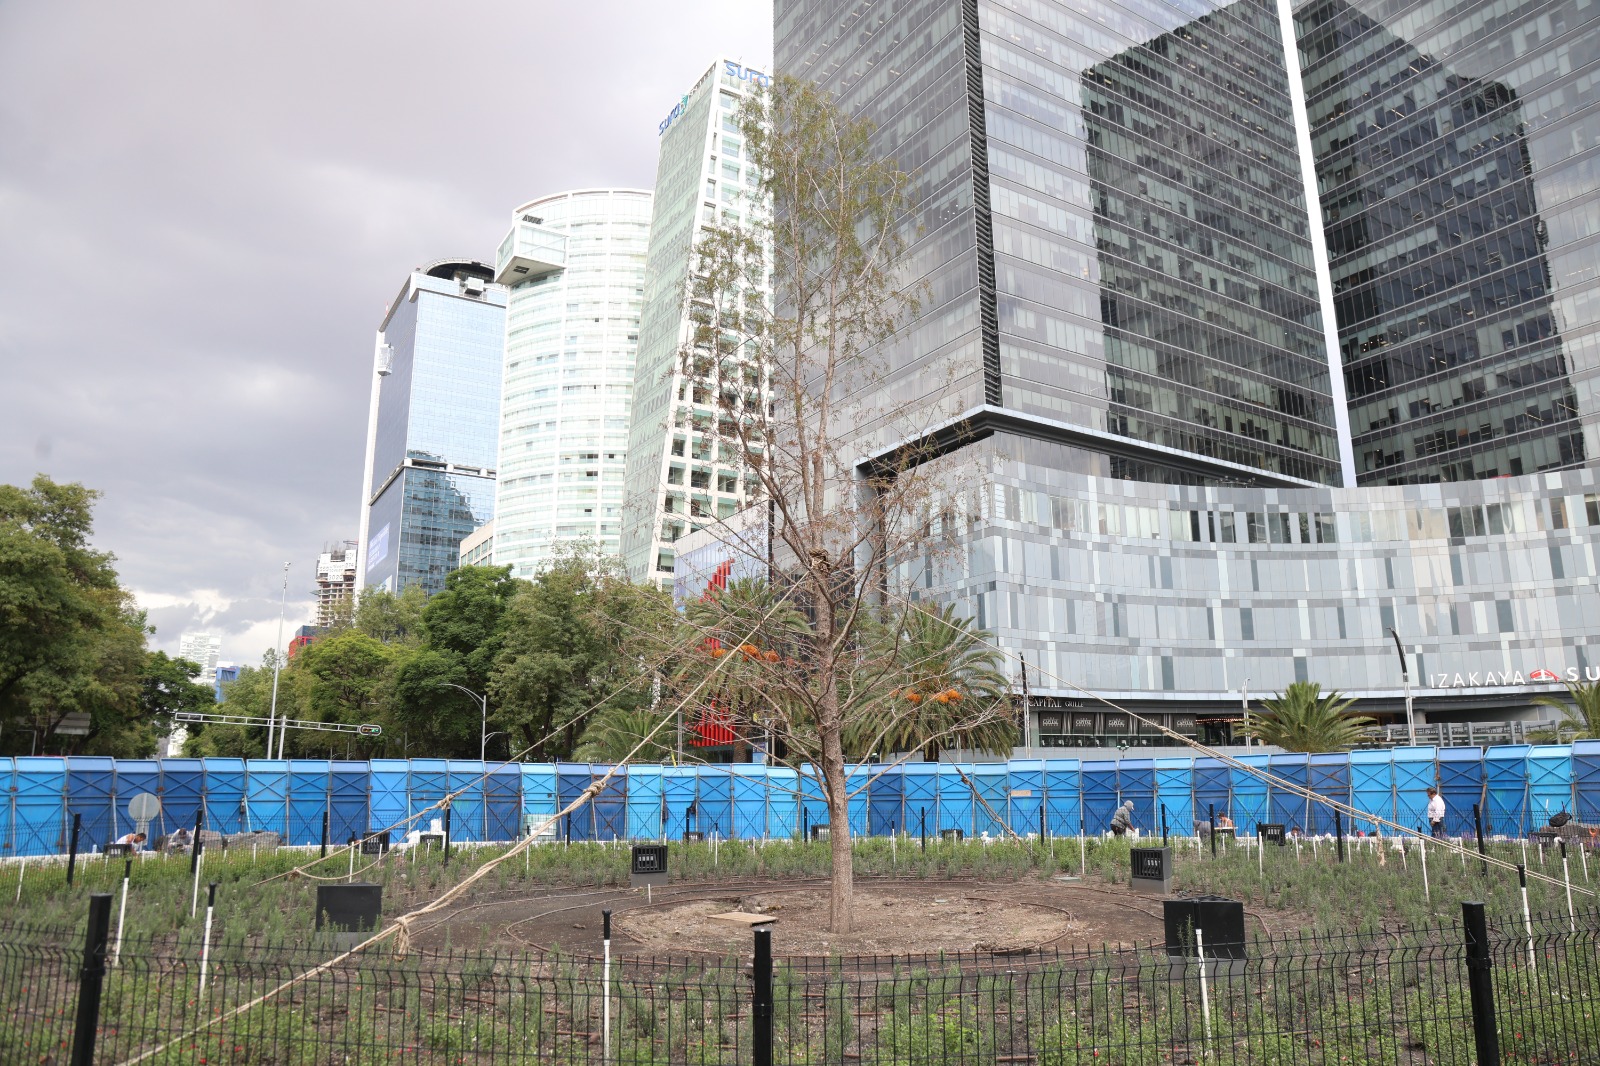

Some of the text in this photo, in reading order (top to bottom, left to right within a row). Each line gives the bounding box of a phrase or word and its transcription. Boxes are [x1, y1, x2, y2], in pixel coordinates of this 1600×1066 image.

[726, 62, 769, 88] sura
[659, 102, 680, 136] sura
[1430, 671, 1526, 689] IZAKAYA
